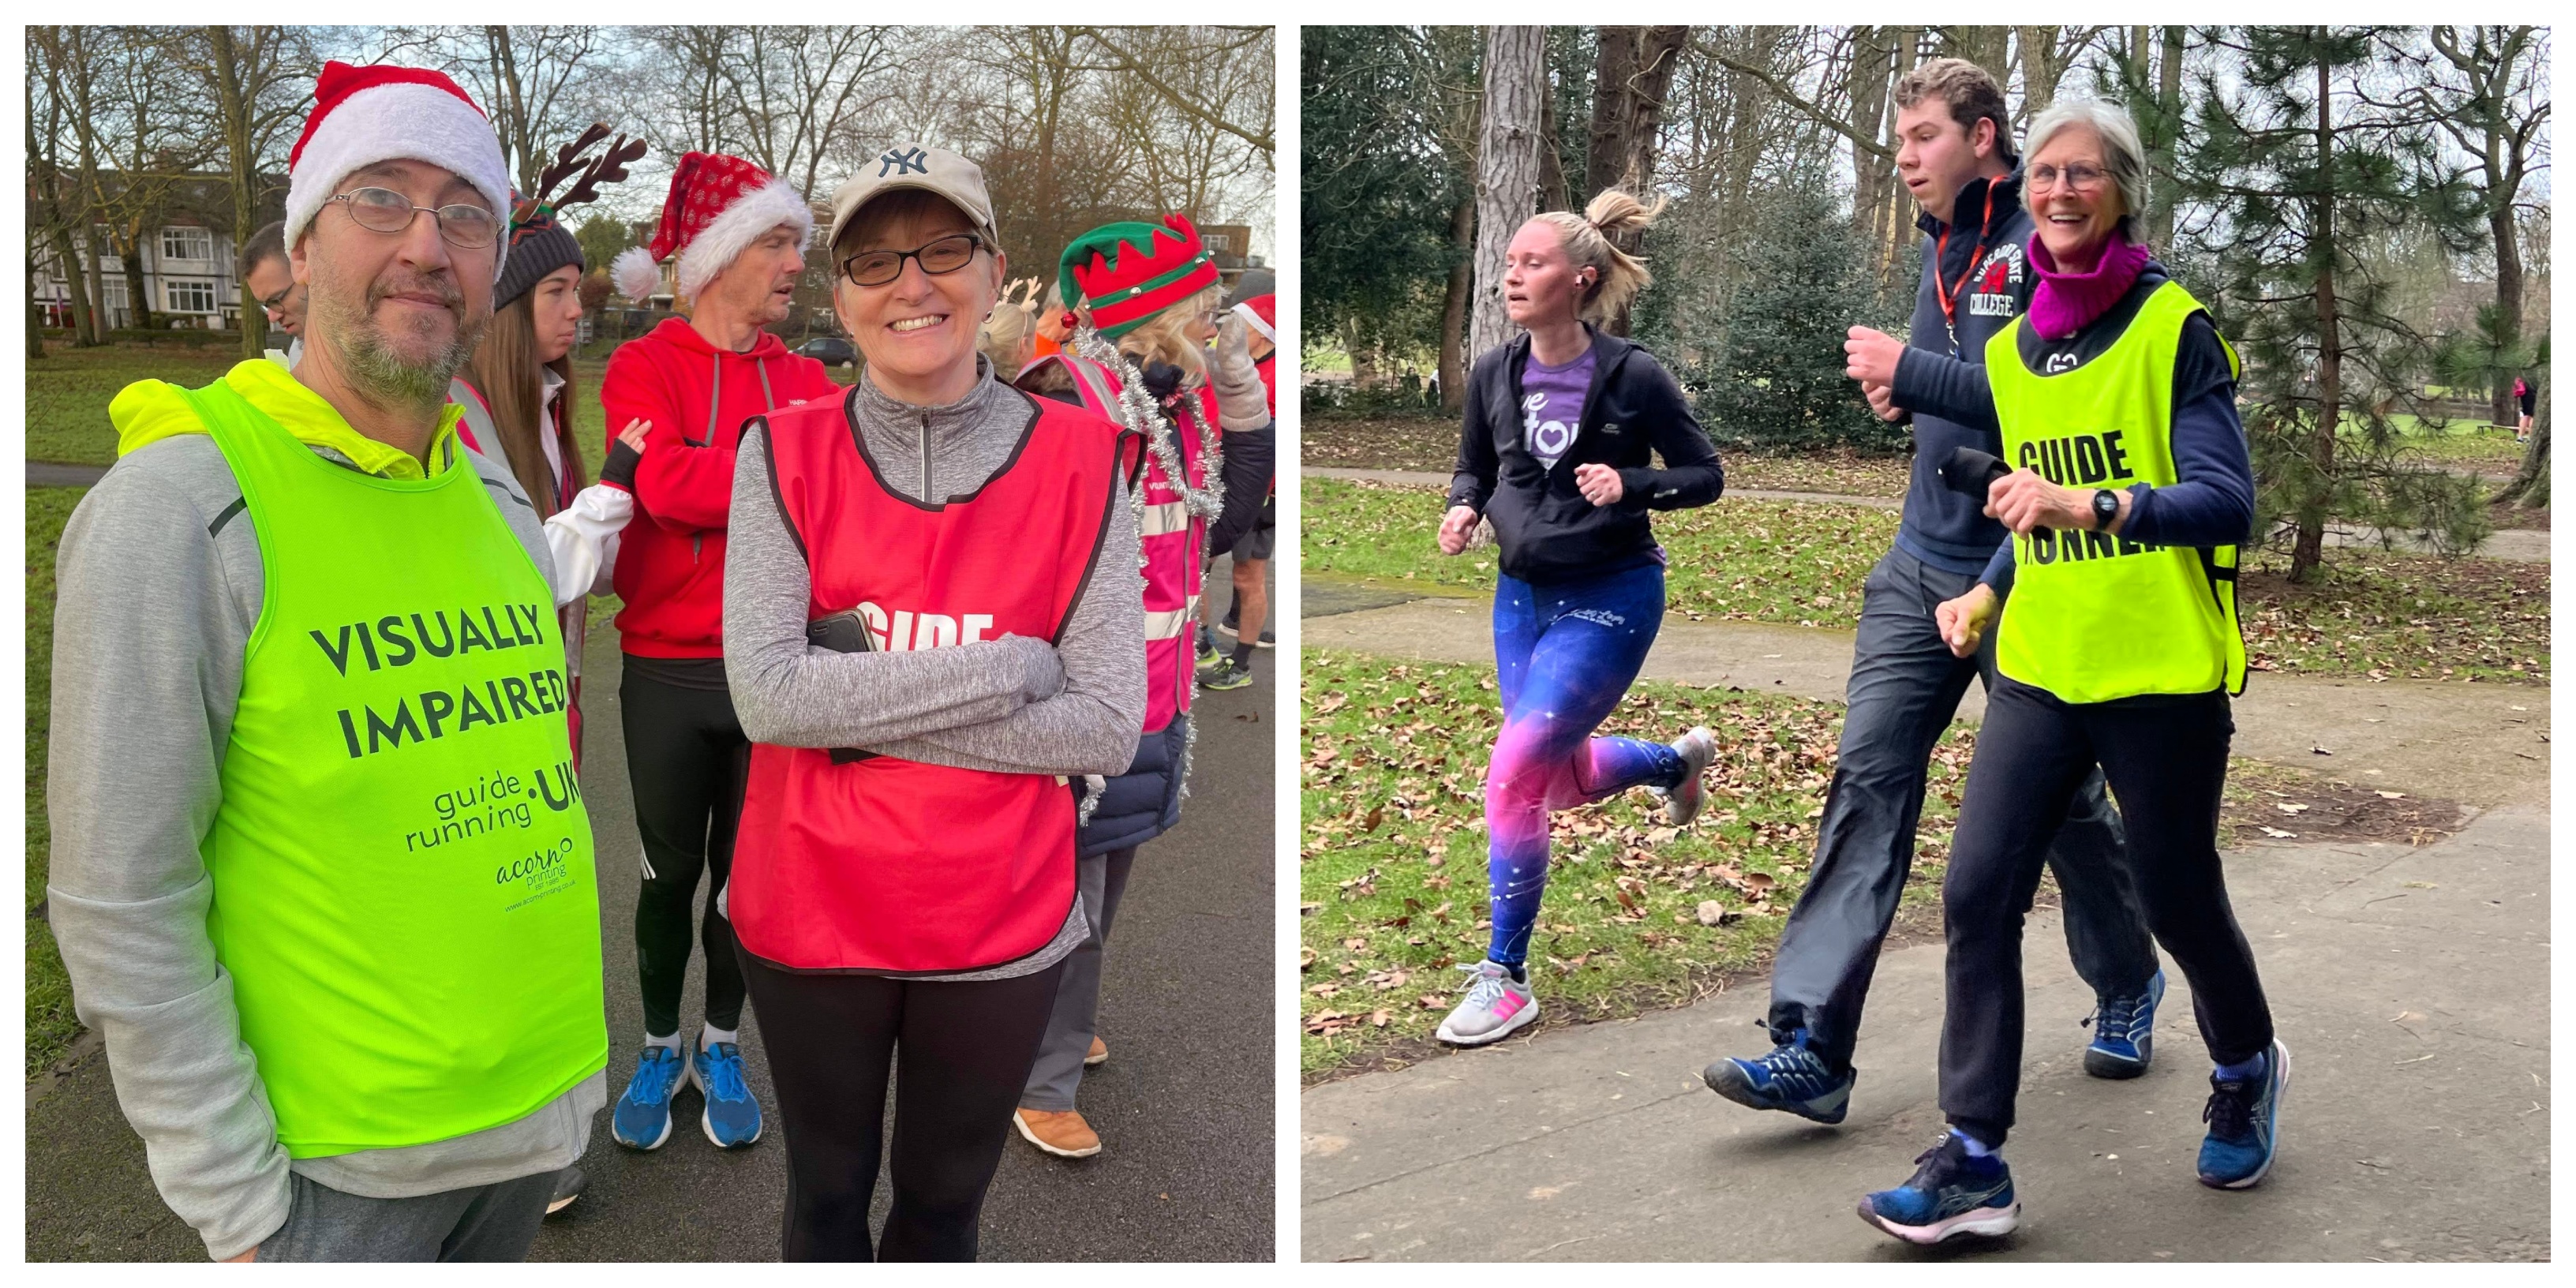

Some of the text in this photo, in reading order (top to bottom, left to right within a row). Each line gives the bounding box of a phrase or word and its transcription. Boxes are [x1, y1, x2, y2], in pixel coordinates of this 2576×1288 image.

[878, 146, 929, 178] NY
[1969, 293, 2014, 317] COLLEGE
[2019, 429, 2134, 486] GUIDE
[309, 604, 544, 679] VISUALLY
[337, 669, 566, 759] IMPAIRED
[434, 769, 522, 821] guide
[406, 802, 532, 852] running
[496, 847, 565, 885] acorn
[526, 864, 567, 890] printing
[535, 877, 560, 891] EST 1985
